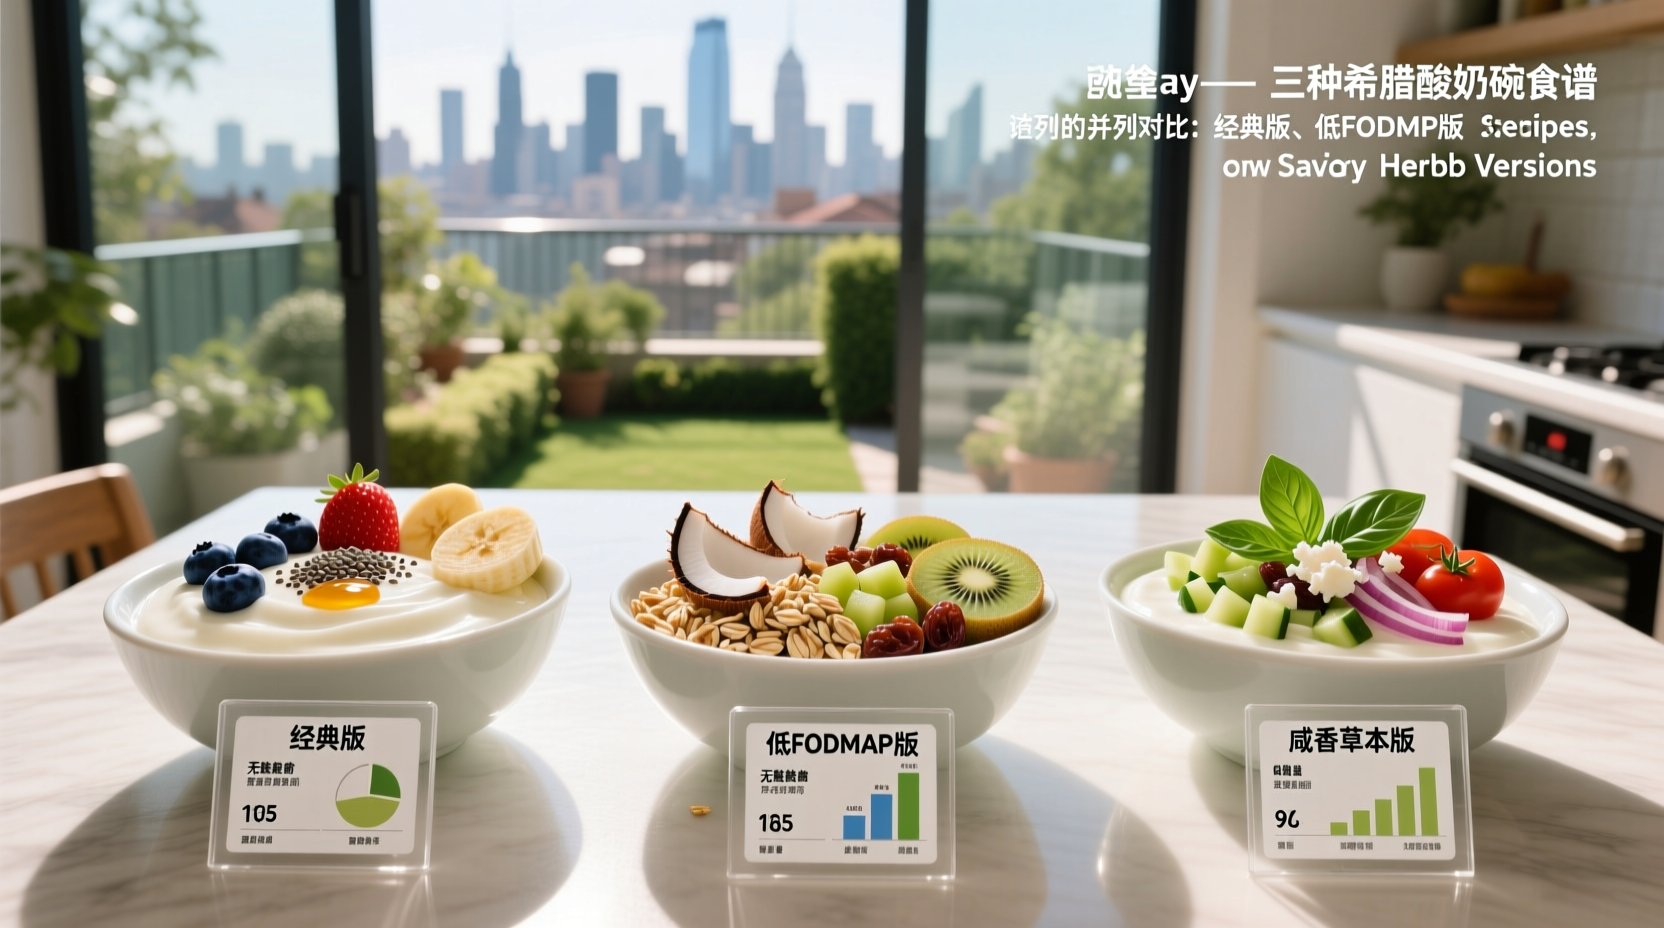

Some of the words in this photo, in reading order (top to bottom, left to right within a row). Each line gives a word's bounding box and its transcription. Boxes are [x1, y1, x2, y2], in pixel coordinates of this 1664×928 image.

[289, 724, 366, 751] 经典版
[766, 731, 919, 757] 低FODMAP版
[1289, 726, 1416, 754] 咸香草本版
[242, 804, 278, 823] 105
